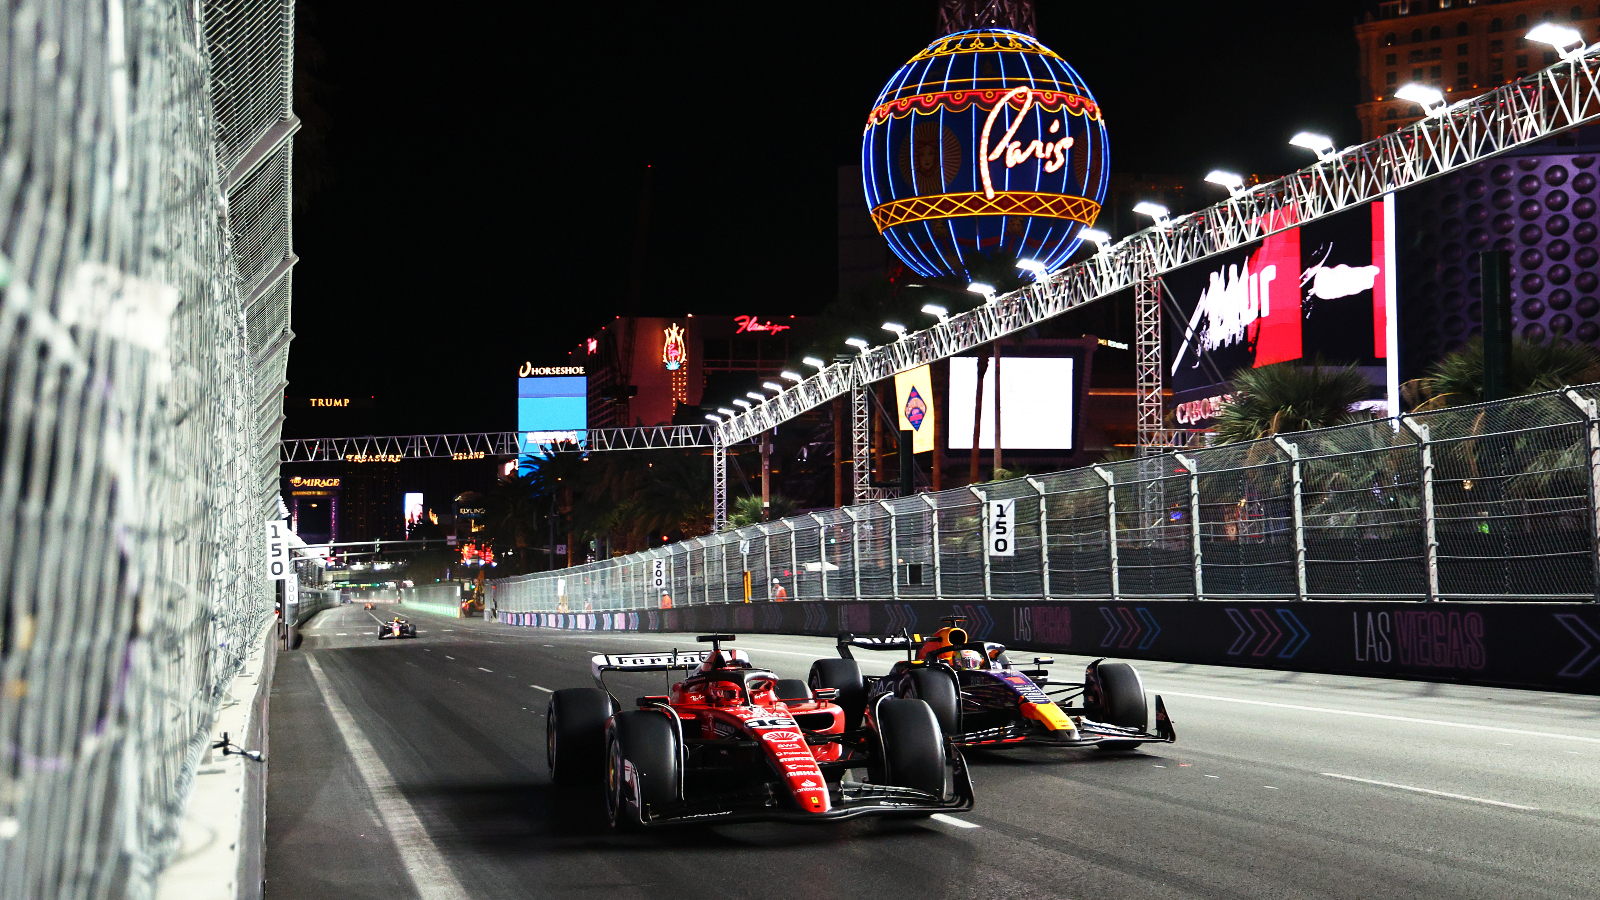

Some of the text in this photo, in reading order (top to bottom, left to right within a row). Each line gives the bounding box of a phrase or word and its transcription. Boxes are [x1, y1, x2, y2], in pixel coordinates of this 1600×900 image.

[979, 85, 1074, 200] Paris
[734, 315, 790, 335] Flamingo
[531, 366, 586, 376] HORSESHOE
[310, 398, 350, 407] TRUMP
[345, 451, 485, 463] TREASURE ISLAND
[293, 478, 340, 487] MIRAGE
[994, 503, 1008, 553] 150
[271, 524, 284, 576] 150
[655, 560, 663, 587] 200
[1013, 607, 1031, 642] LAS
[1353, 611, 1486, 670] LAS VEGAS
